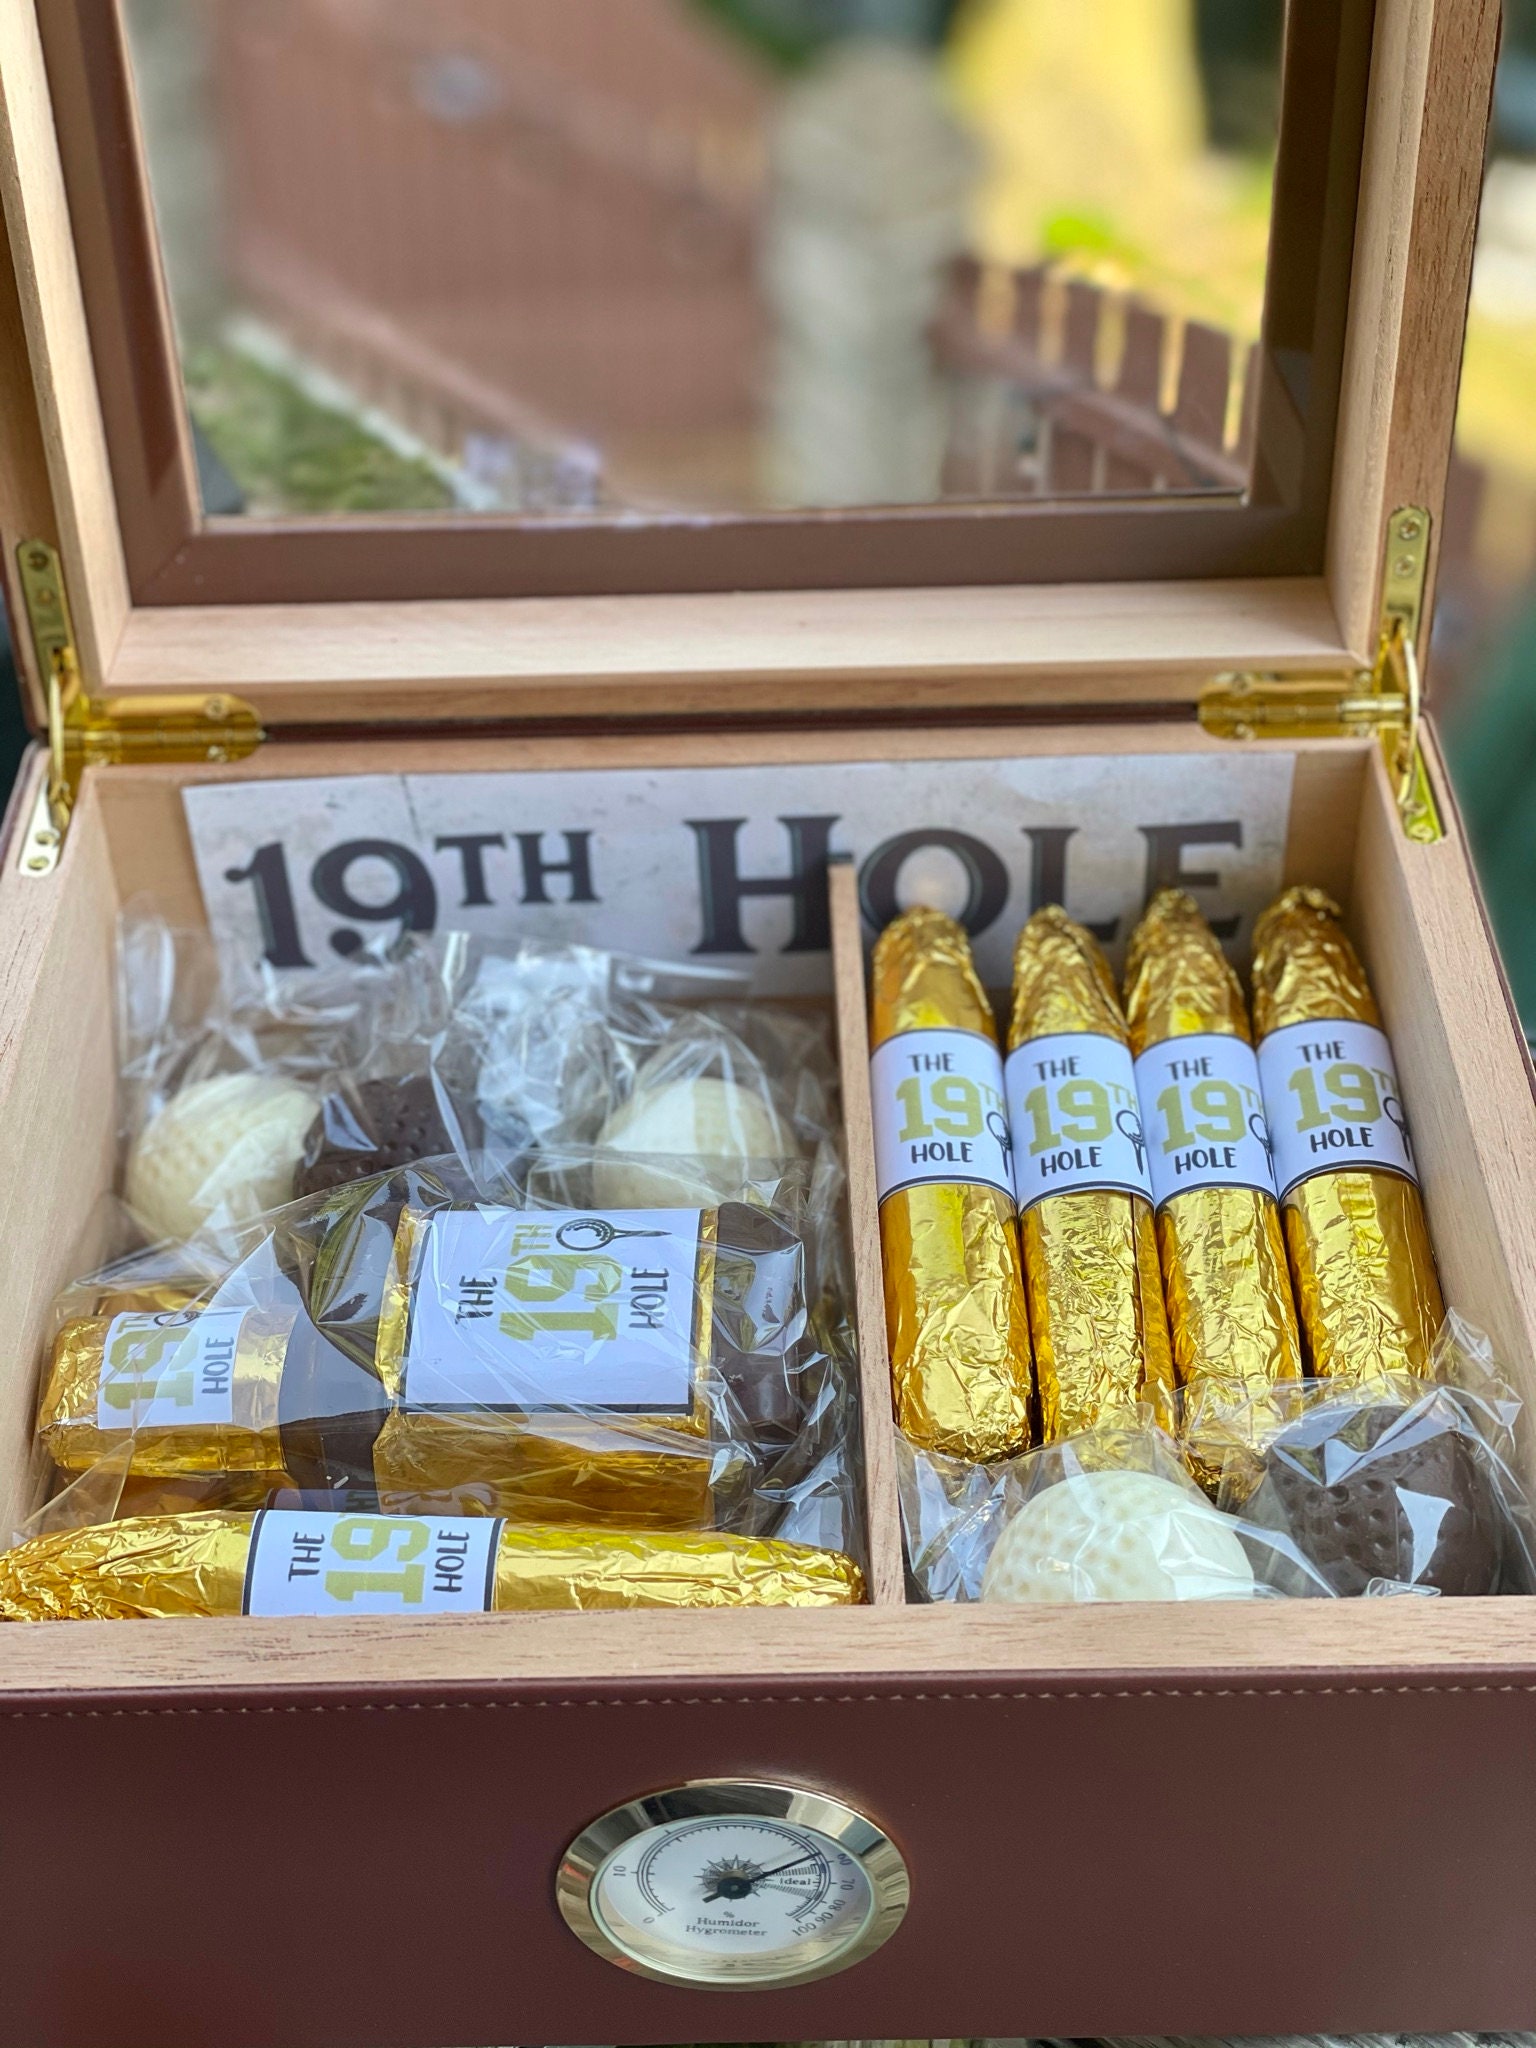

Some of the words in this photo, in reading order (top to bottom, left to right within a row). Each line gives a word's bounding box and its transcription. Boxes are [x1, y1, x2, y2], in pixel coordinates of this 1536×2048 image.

[224, 830, 604, 968] 19TH
[683, 815, 1243, 954] HOLE
[907, 1053, 955, 1073] THE
[1297, 1041, 1347, 1063] THE
[1033, 1056, 1081, 1081] THE
[1166, 1057, 1213, 1080] THE
[1310, 1127, 1374, 1153] HOLE
[911, 1142, 973, 1164] HOLE
[1040, 1147, 1102, 1177] HOLE
[1175, 1147, 1237, 1175] HOLE
[455, 1275, 498, 1325] THE
[628, 1266, 669, 1329] HOLE
[202, 1337, 234, 1395] HOLE
[288, 1531, 325, 1582] THE
[433, 1530, 470, 1593] HOLE
[612, 1865, 626, 1877] 10
[780, 1877, 811, 1885] ideal
[840, 1878, 855, 1891] 70
[828, 1899, 846, 1911] 80
[697, 1917, 760, 1928] Humidor
[815, 1911, 833, 1924] 90
[685, 1925, 768, 1937] Hygrometer
[792, 1922, 816, 1936] 100
